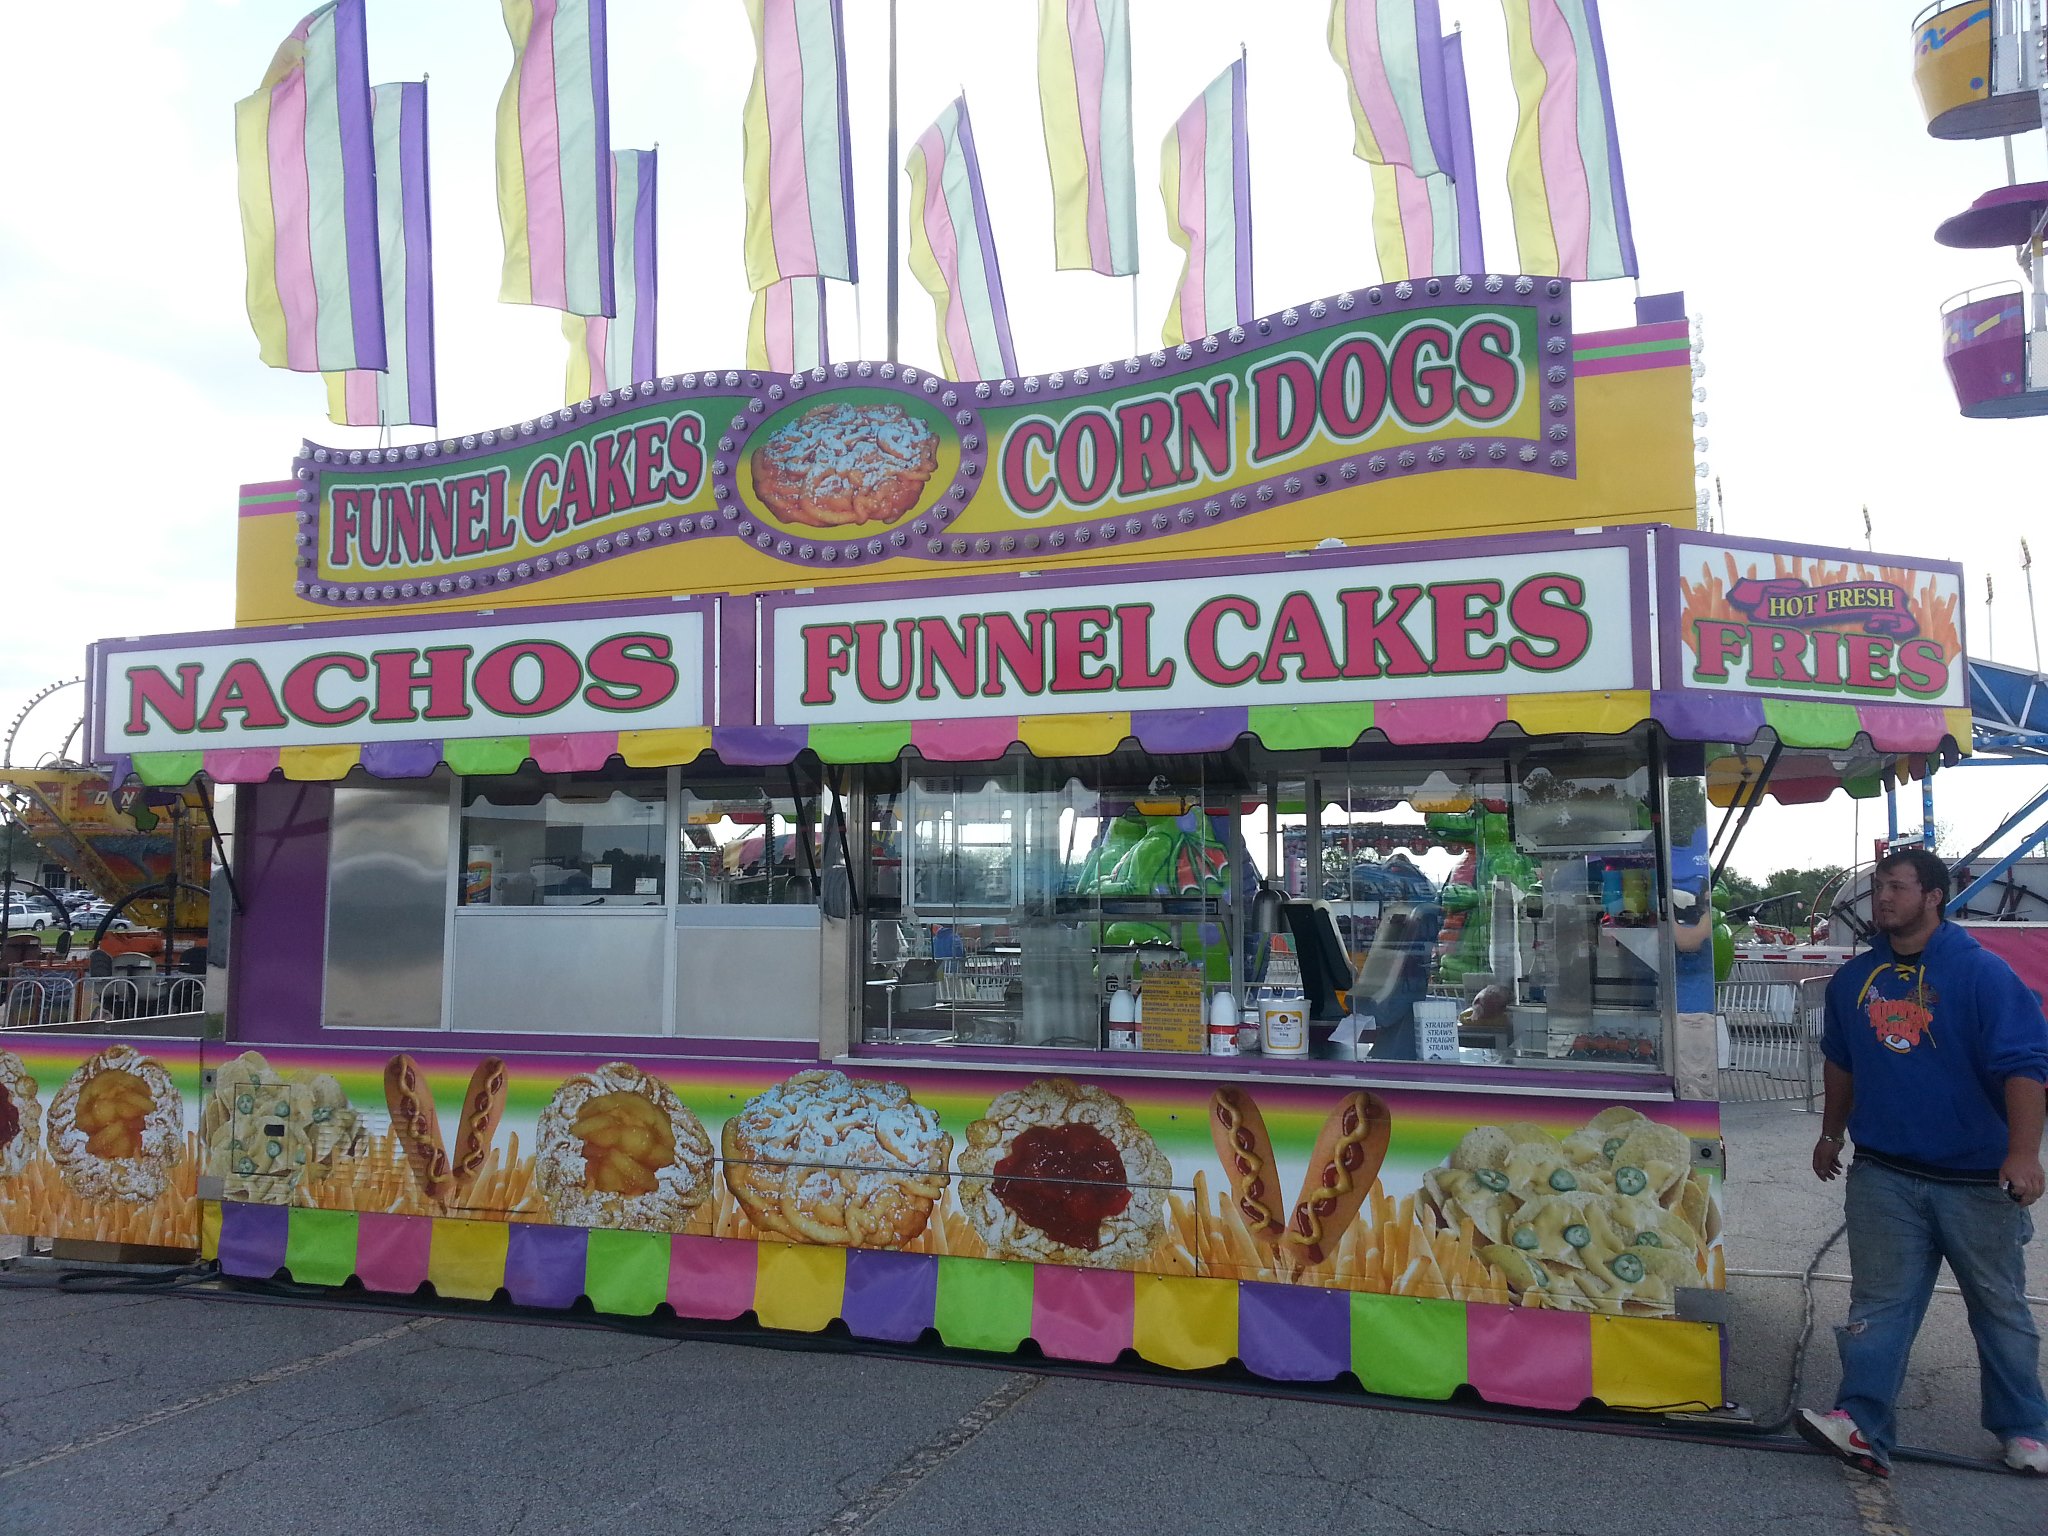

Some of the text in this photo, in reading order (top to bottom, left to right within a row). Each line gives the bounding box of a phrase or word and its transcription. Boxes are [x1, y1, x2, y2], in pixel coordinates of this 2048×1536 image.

[1001, 318, 1520, 513] CORN DOGS
[329, 413, 704, 566] FUNNEL CAKES
[799, 572, 1593, 706] FUNNEL CAKES
[1768, 586, 1896, 618] HOT FRESH
[123, 631, 680, 736] NACHOS
[1692, 617, 1950, 700] FRIES
[1424, 1021, 1455, 1029] STRAIGHT
[1425, 1036, 1456, 1044] STRAIGHT
